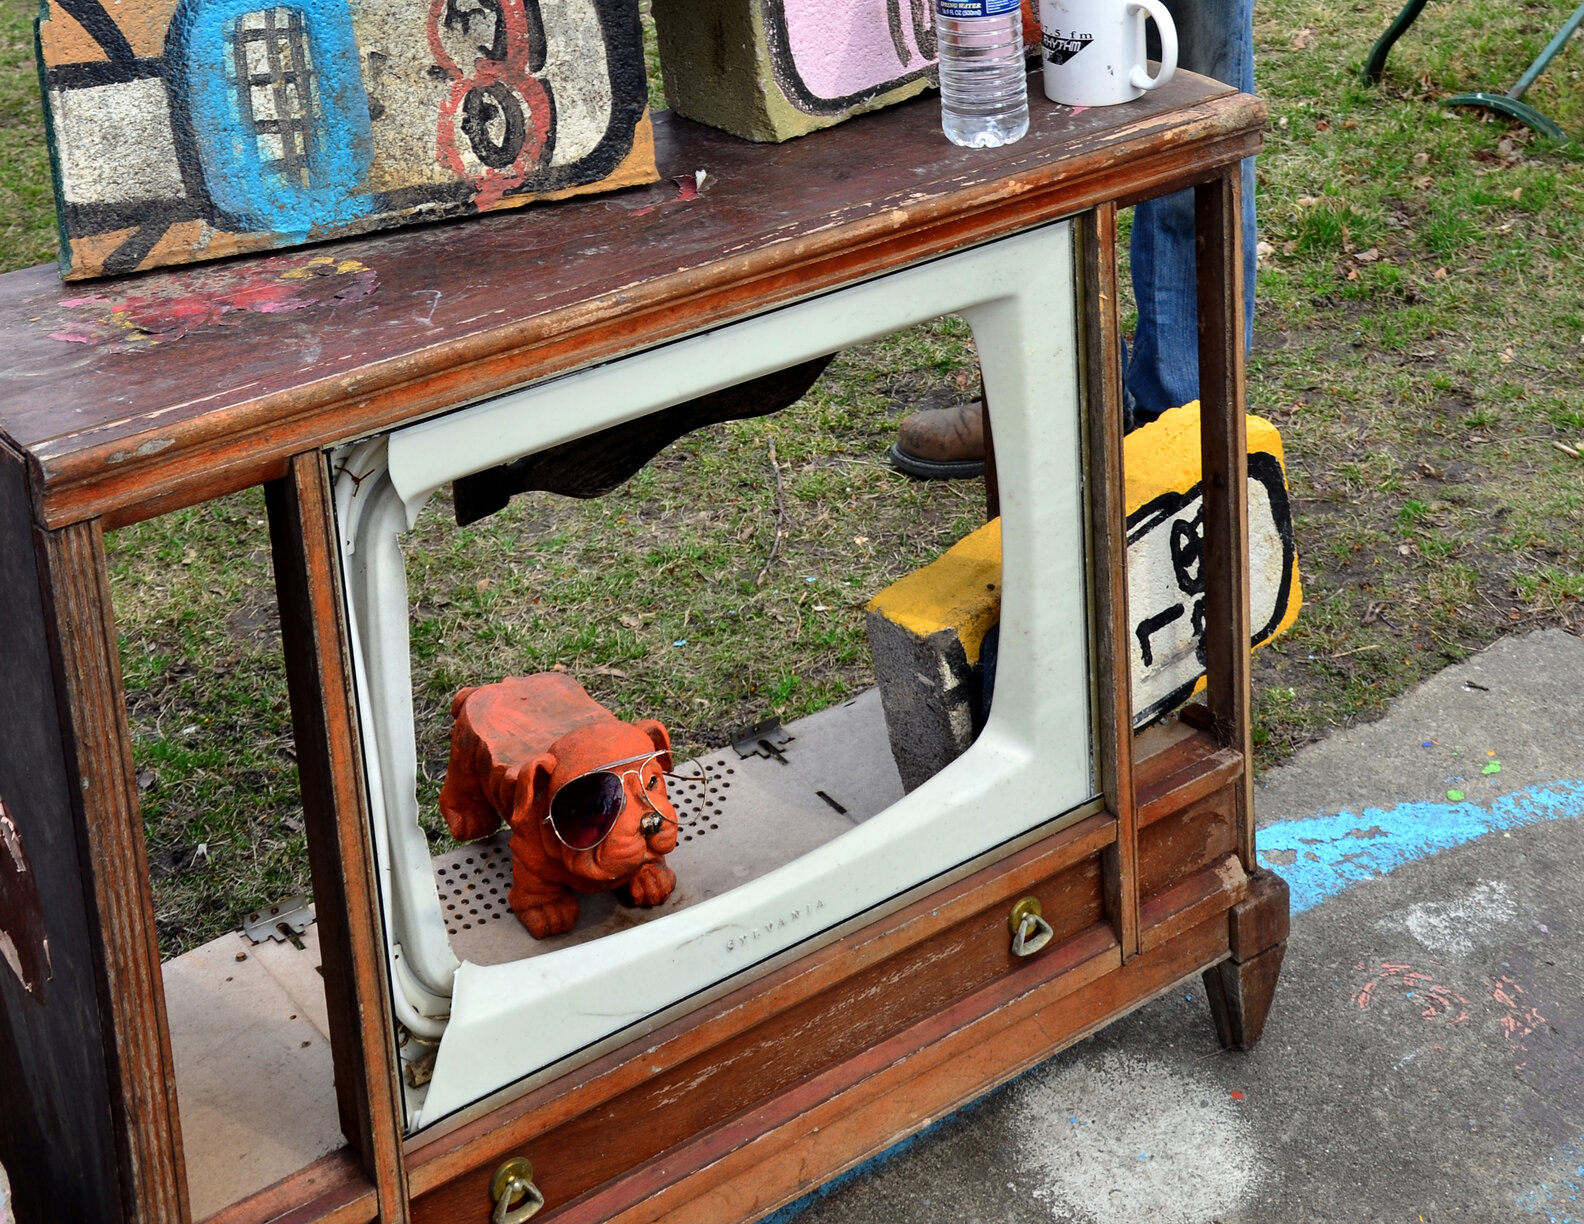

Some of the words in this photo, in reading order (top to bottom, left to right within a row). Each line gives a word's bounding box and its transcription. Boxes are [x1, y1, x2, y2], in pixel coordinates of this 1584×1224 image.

[958, 2, 982, 10] WATER
[1043, 34, 1082, 53] RHYTHM
[726, 899, 825, 951] SYLVANIA
